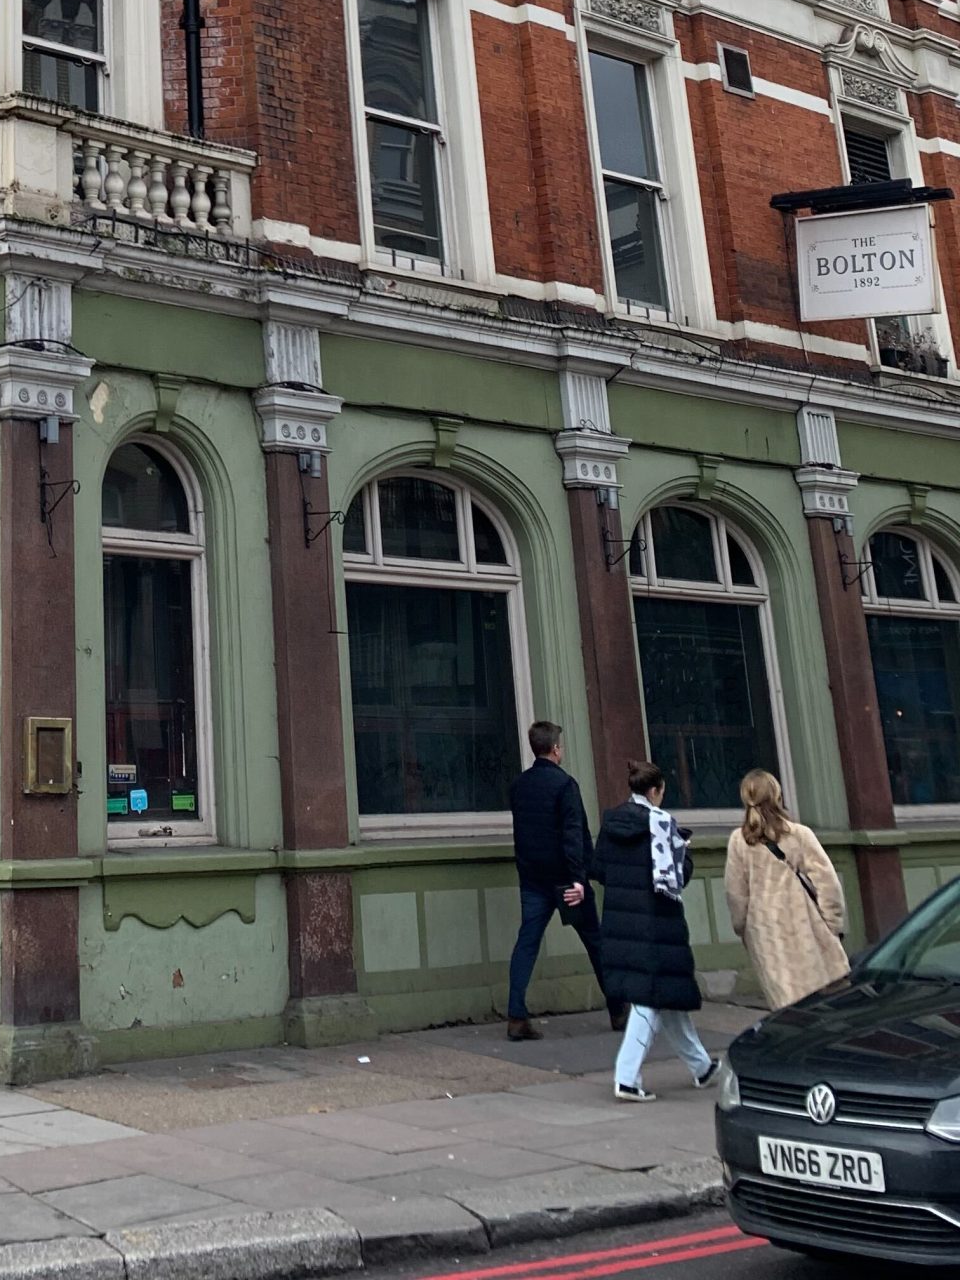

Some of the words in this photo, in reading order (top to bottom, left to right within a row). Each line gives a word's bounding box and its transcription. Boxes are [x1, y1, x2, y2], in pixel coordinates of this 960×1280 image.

[851, 237, 876, 248] THE
[816, 249, 915, 276] BOLTON
[853, 276, 880, 289] 1892
[767, 1142, 821, 1177] VN66
[826, 1152, 872, 1185] ZRO
